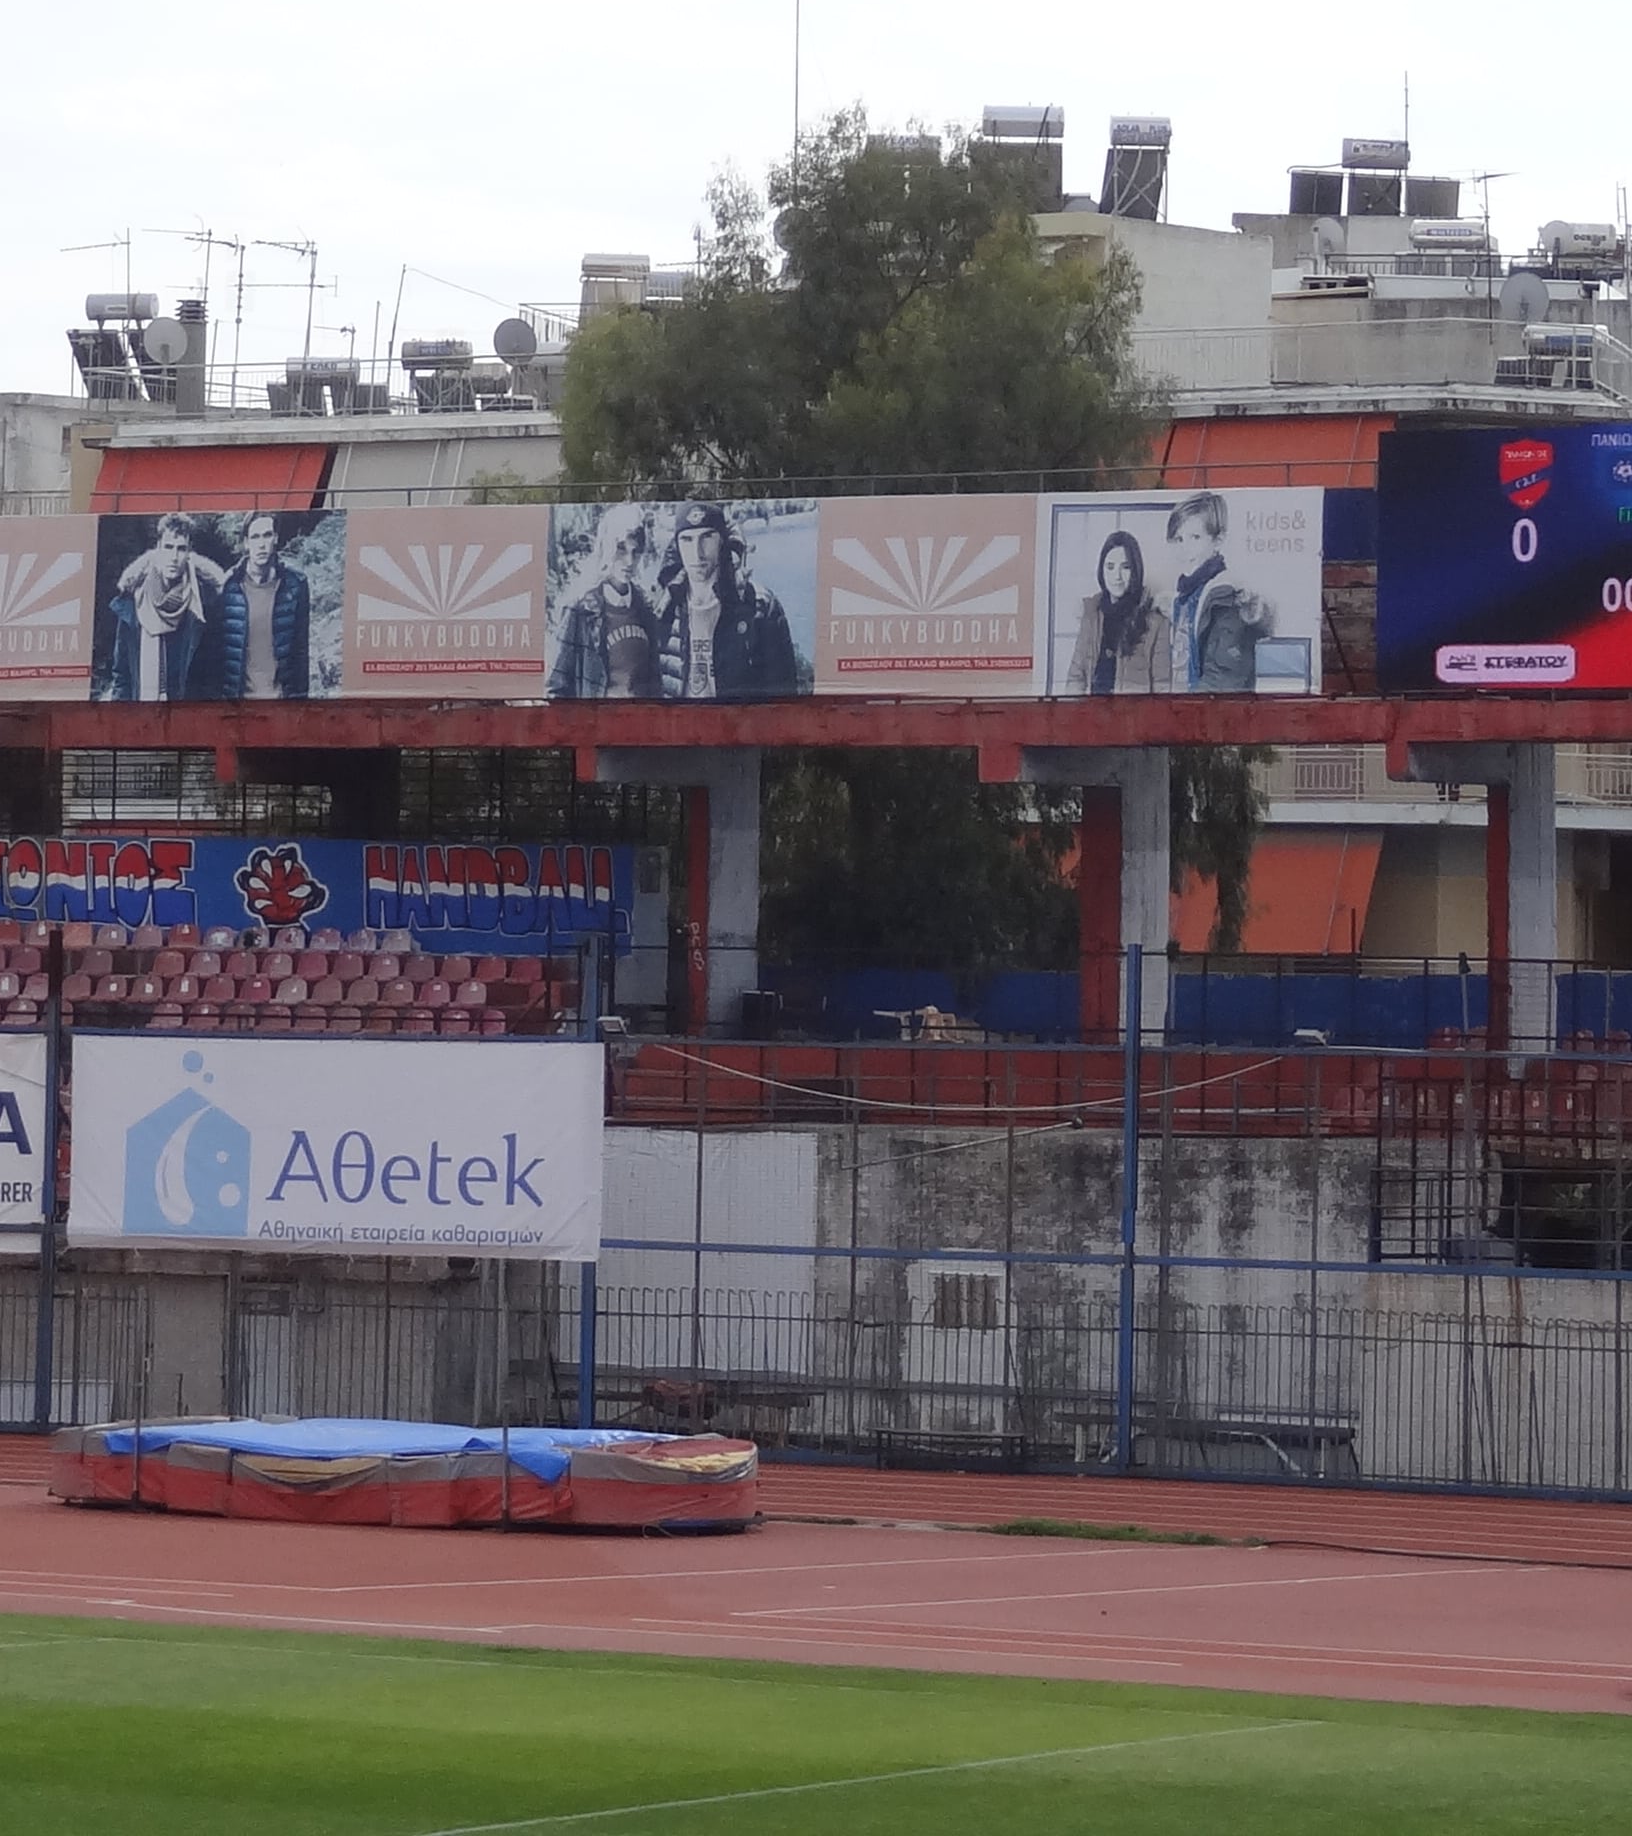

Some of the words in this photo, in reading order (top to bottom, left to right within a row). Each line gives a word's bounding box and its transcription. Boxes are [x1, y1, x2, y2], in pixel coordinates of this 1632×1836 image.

[1245, 535, 1305, 553] teens
[1512, 518, 1538, 562] 0
[355, 623, 532, 648] FUNKYBUDDHA
[829, 618, 1019, 645] FUNKYBUDDHA
[363, 844, 631, 938] HANDBALL
[258, 1219, 344, 1245] Αθηναϊκή
[350, 1221, 426, 1246] εταιρεία
[431, 1222, 544, 1248] καθαρισμών
